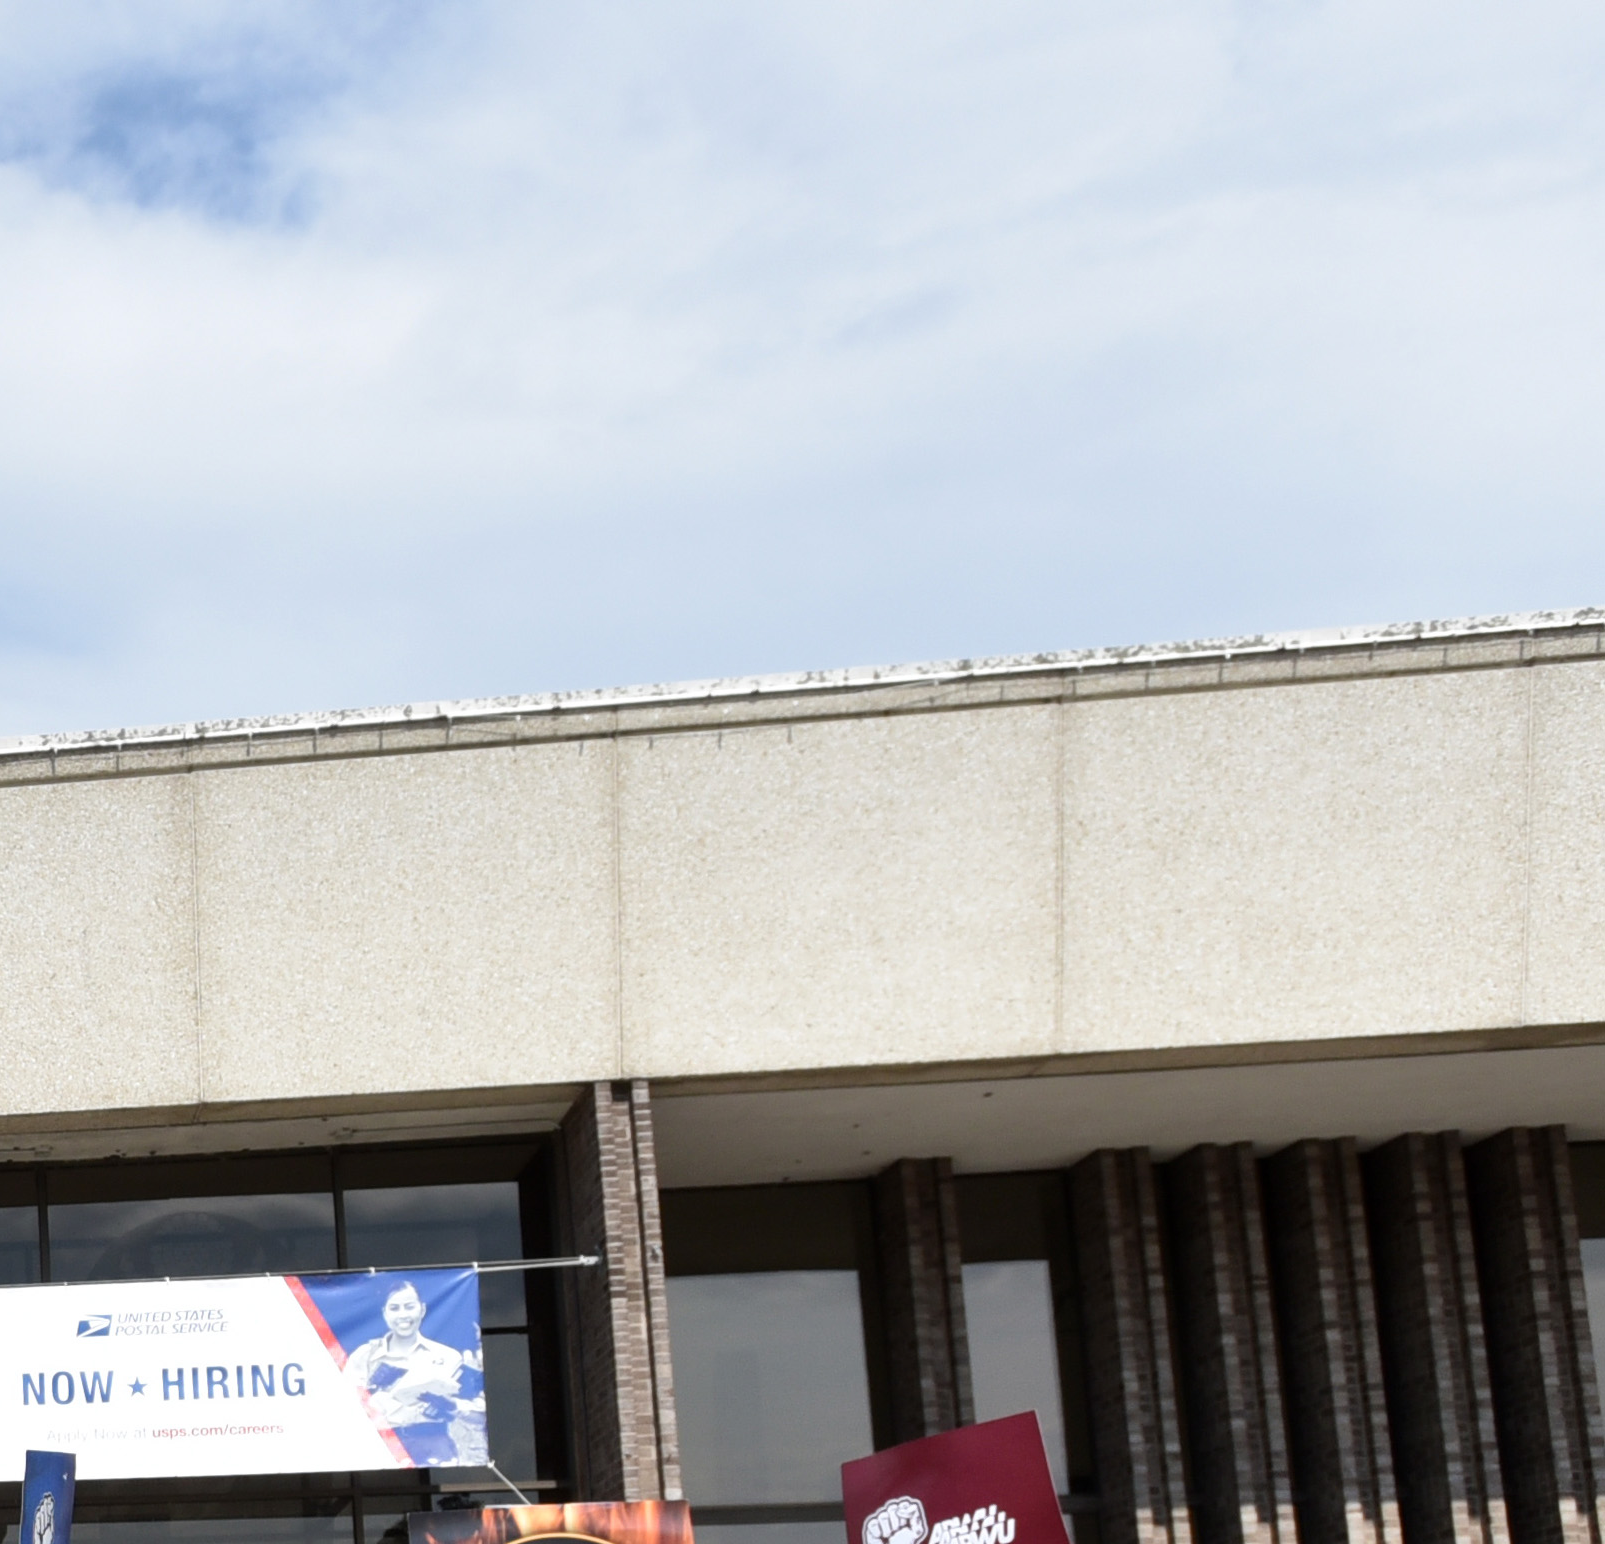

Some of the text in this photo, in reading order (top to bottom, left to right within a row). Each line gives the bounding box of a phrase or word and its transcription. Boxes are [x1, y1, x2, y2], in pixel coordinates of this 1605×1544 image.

[116, 1309, 224, 1325] UNITED STATES
[115, 1321, 229, 1337] POSTAL SERVICE
[22, 1362, 307, 1406] NOW HIRING
[46, 1429, 88, 1444] Apply
[94, 1428, 128, 1440] Now
[152, 1423, 285, 1441] usps.com/careers
